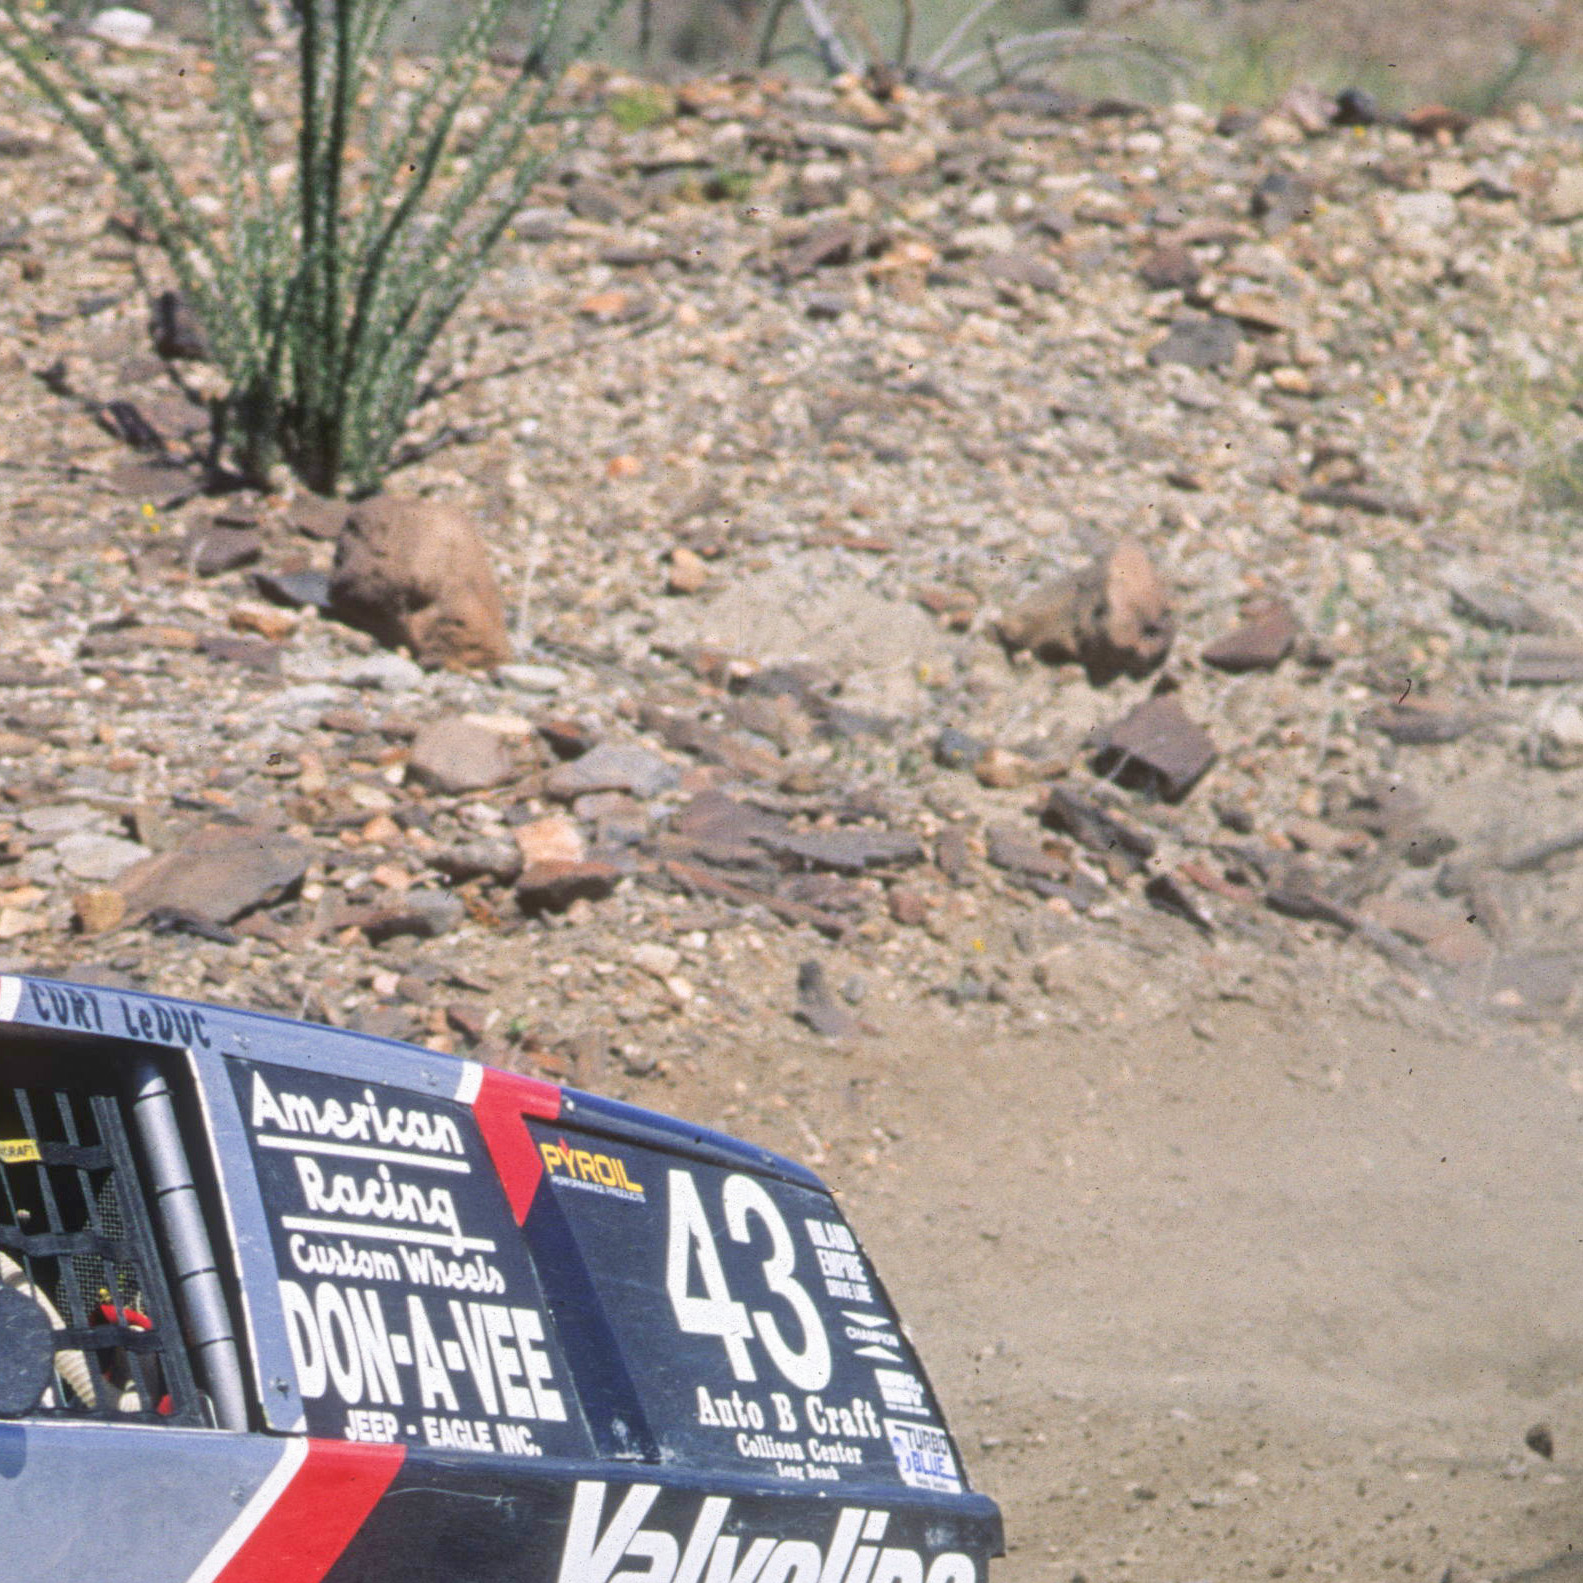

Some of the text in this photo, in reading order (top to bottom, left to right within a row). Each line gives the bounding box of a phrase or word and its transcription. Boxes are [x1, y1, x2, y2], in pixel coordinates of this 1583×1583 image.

[29, 983, 211, 1048] CURT LeDUC
[252, 1070, 465, 1154] American
[539, 1142, 644, 1193] PYROIL
[293, 1156, 465, 1256] Racing
[290, 1235, 507, 1294] Custom Wheels
[667, 1170, 831, 1391] 43
[278, 1280, 567, 1422] DON-A-VEE
[344, 1410, 398, 1443] JEEP
[422, 1416, 495, 1453] EAGLE
[496, 1424, 543, 1457] INC.
[696, 1386, 881, 1439] Auto B Craft
[894, 1424, 947, 1455] TURBO
[807, 1437, 862, 1465] Center
[911, 1450, 958, 1480] BLUE
